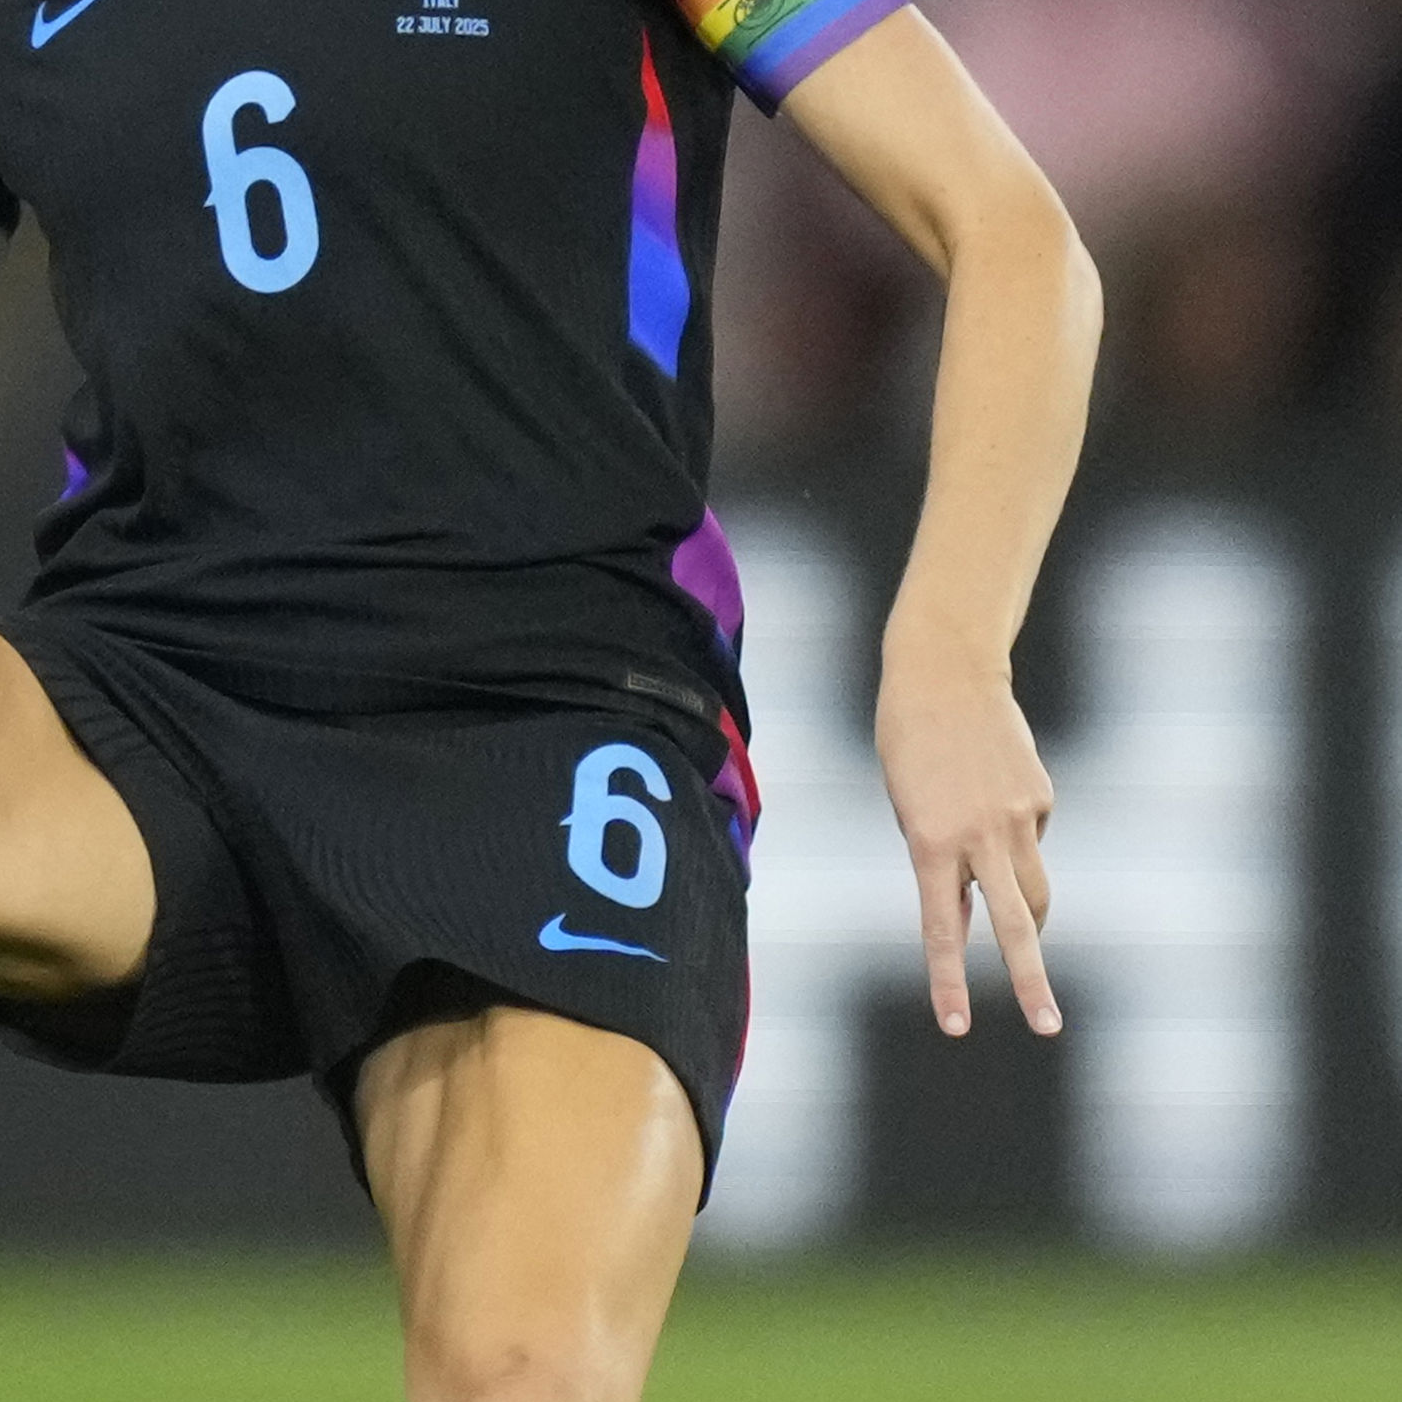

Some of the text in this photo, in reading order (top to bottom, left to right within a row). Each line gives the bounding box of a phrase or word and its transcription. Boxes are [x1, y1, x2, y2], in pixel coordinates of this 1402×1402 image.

[396, 16, 490, 36] 22 JULY 2025
[202, 70, 319, 294] 6
[559, 743, 672, 908] 6
[708, 493, 1402, 1253] H
